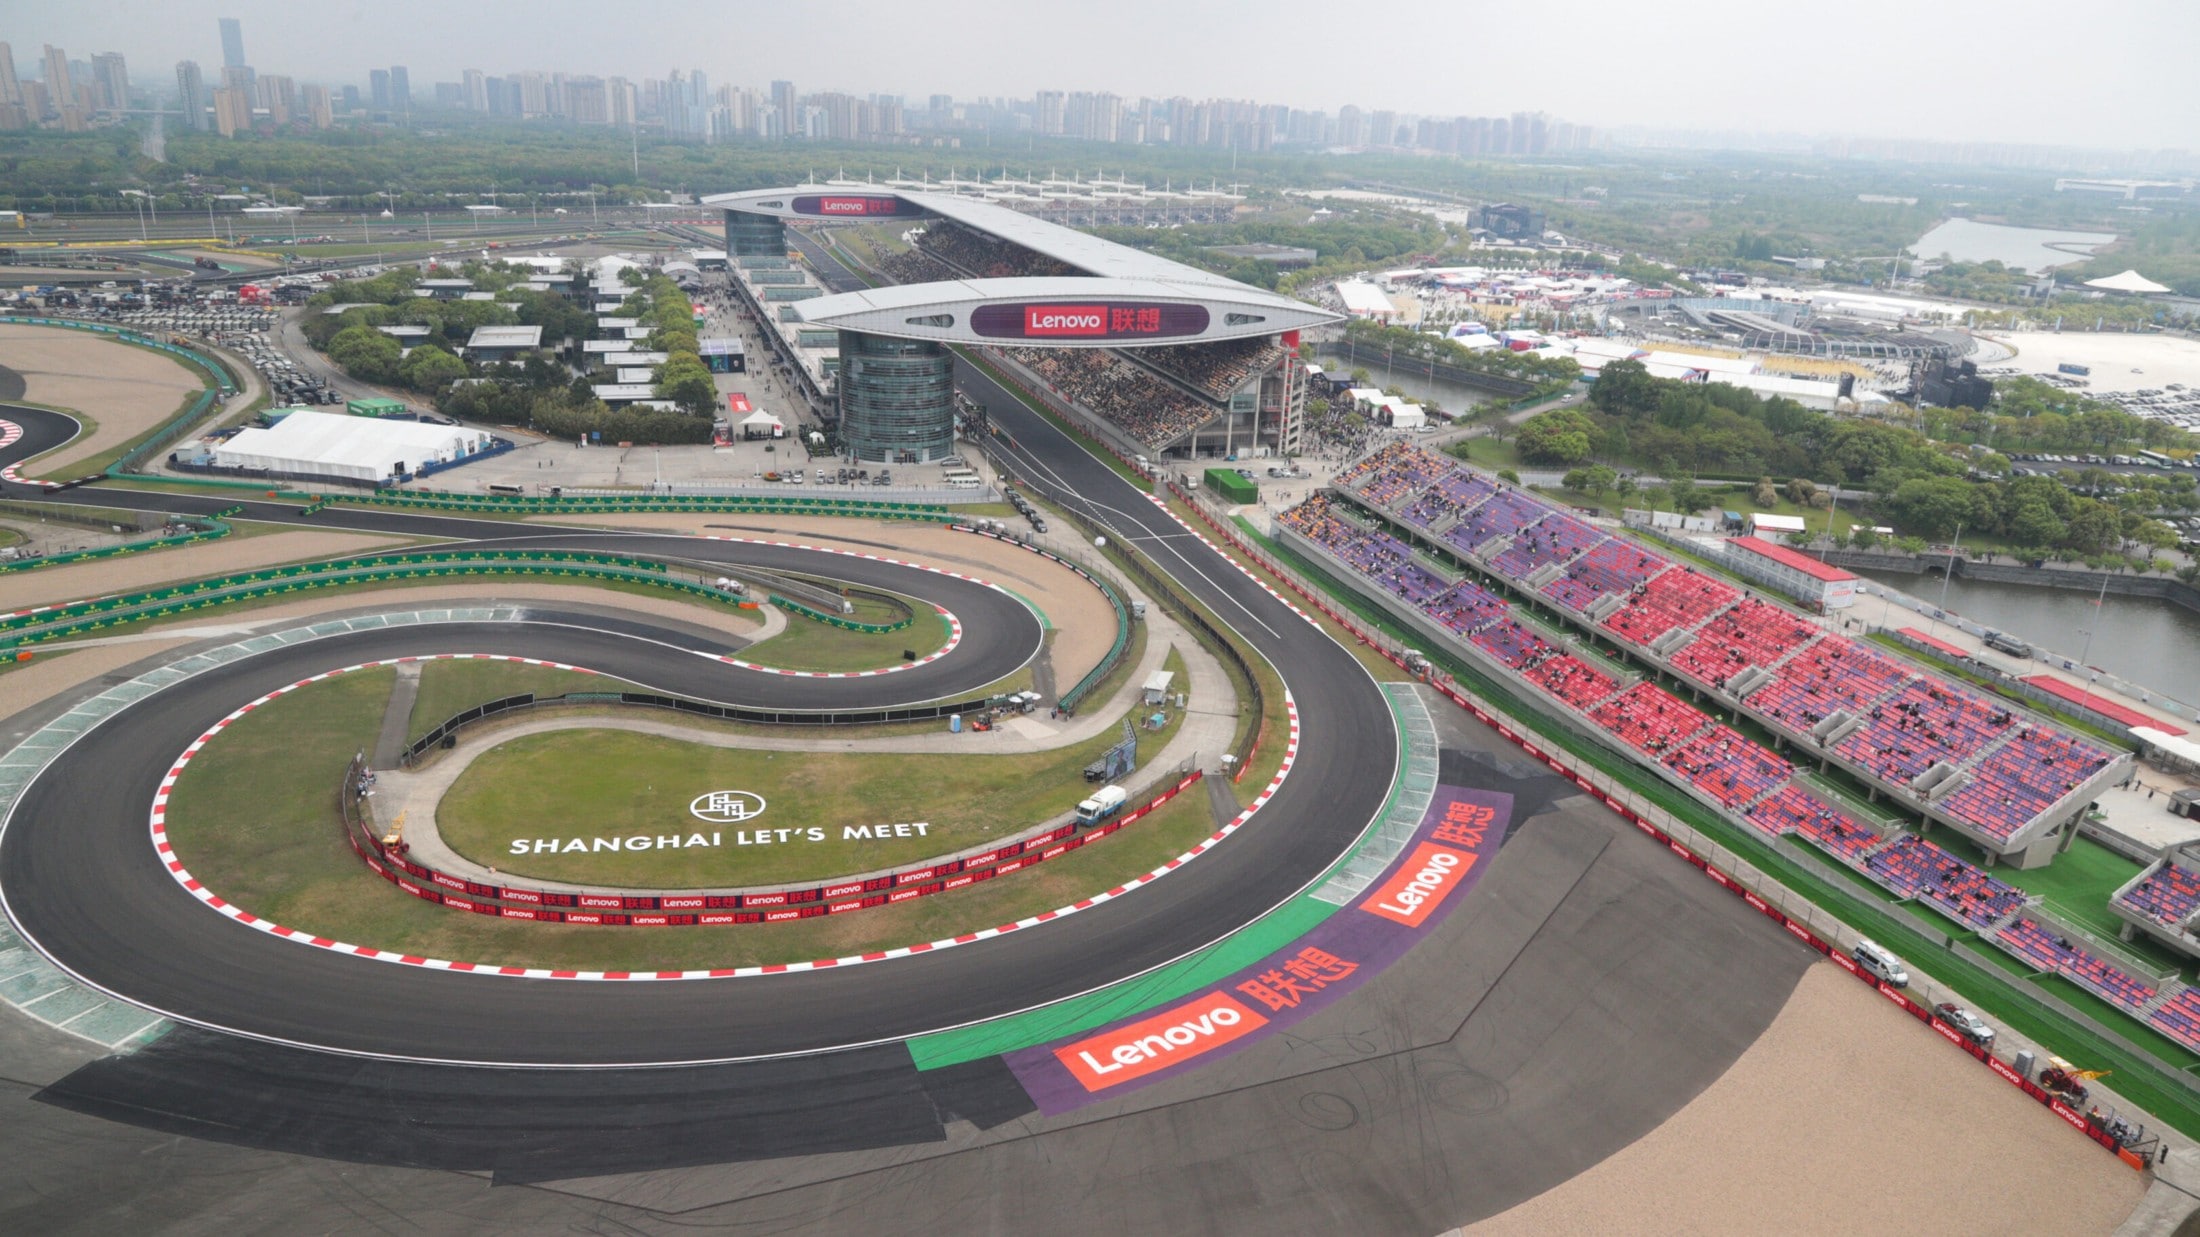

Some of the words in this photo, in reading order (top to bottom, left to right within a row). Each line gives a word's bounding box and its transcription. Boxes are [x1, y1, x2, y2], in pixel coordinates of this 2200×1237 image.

[825, 201, 863, 211] Lenovo
[1032, 312, 1101, 329] Lenovo
[1111, 308, 1160, 332] 联想
[509, 832, 720, 854] SHANGHAI
[737, 827, 825, 845] LET'S
[842, 823, 929, 840] MEET
[1026, 835, 1053, 849] Lenovo
[1044, 847, 1065, 858] Lenovo
[1378, 852, 1459, 916] Lenovo
[1430, 801, 1495, 848] 联想
[966, 854, 996, 867] Lenovo
[998, 862, 1020, 874] Lenovo
[434, 873, 464, 890] Lenovo
[899, 871, 932, 883] Lenovo
[946, 877, 971, 888] Lenovo
[502, 890, 539, 902] Lenovo
[826, 885, 861, 897] Lenovo
[891, 890, 918, 901] Lenovo
[445, 897, 472, 910] Lenovo
[581, 896, 620, 907] Lenovo
[663, 899, 702, 908] Lenovo
[746, 896, 784, 906] Lenovo
[831, 902, 860, 912] Lenovo
[1745, 892, 1767, 911] Lenovo
[503, 909, 534, 919] Lenovo
[568, 914, 599, 923] Lenovo
[634, 916, 666, 924] Lenovo
[701, 915, 732, 923] Lenovo
[767, 912, 798, 921] Lenovo
[1787, 920, 1809, 940] Lenovo
[1832, 951, 1855, 971] Lenovo
[1880, 983, 1905, 1006] Lenovo
[1079, 1007, 1241, 1075] Lenovo
[1236, 946, 1360, 1012] 联想
[1932, 1020, 1960, 1043] Lenovo
[1990, 1058, 2020, 1084] Lenovo
[2053, 1101, 2085, 1129] Lenovo
